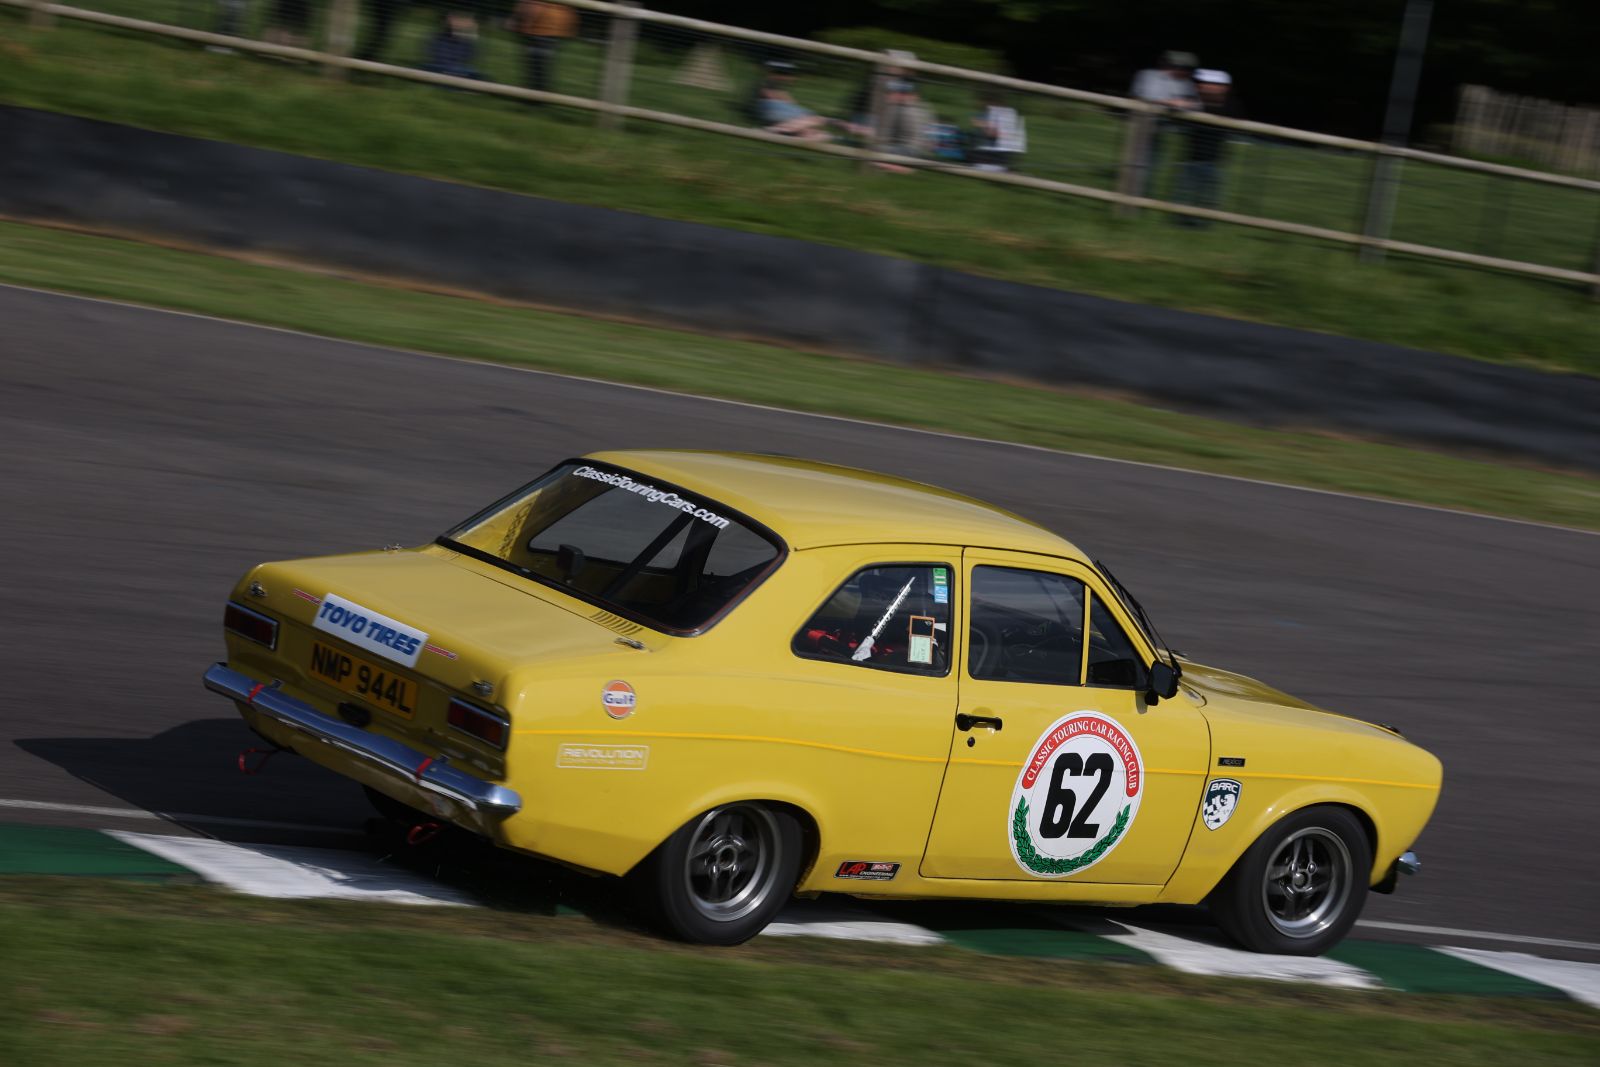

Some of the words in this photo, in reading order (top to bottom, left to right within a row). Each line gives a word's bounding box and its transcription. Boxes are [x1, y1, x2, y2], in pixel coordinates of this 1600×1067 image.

[573, 466, 730, 529] ClassicTouringCars.com
[319, 602, 367, 634] TOYO
[365, 621, 421, 656] TIRES
[311, 642, 352, 683] NMP
[356, 665, 411, 713] 944L
[604, 693, 634, 705] Gulf
[561, 748, 643, 759] REVOLUTION
[1027, 739, 1054, 781] CLASSIC
[1053, 720, 1089, 743] TOURING
[1090, 721, 1107, 735] CAR
[1107, 730, 1133, 762] RACING
[1127, 762, 1137, 789] CLUB
[1039, 752, 1114, 839] 62
[1210, 782, 1238, 793] BARC
